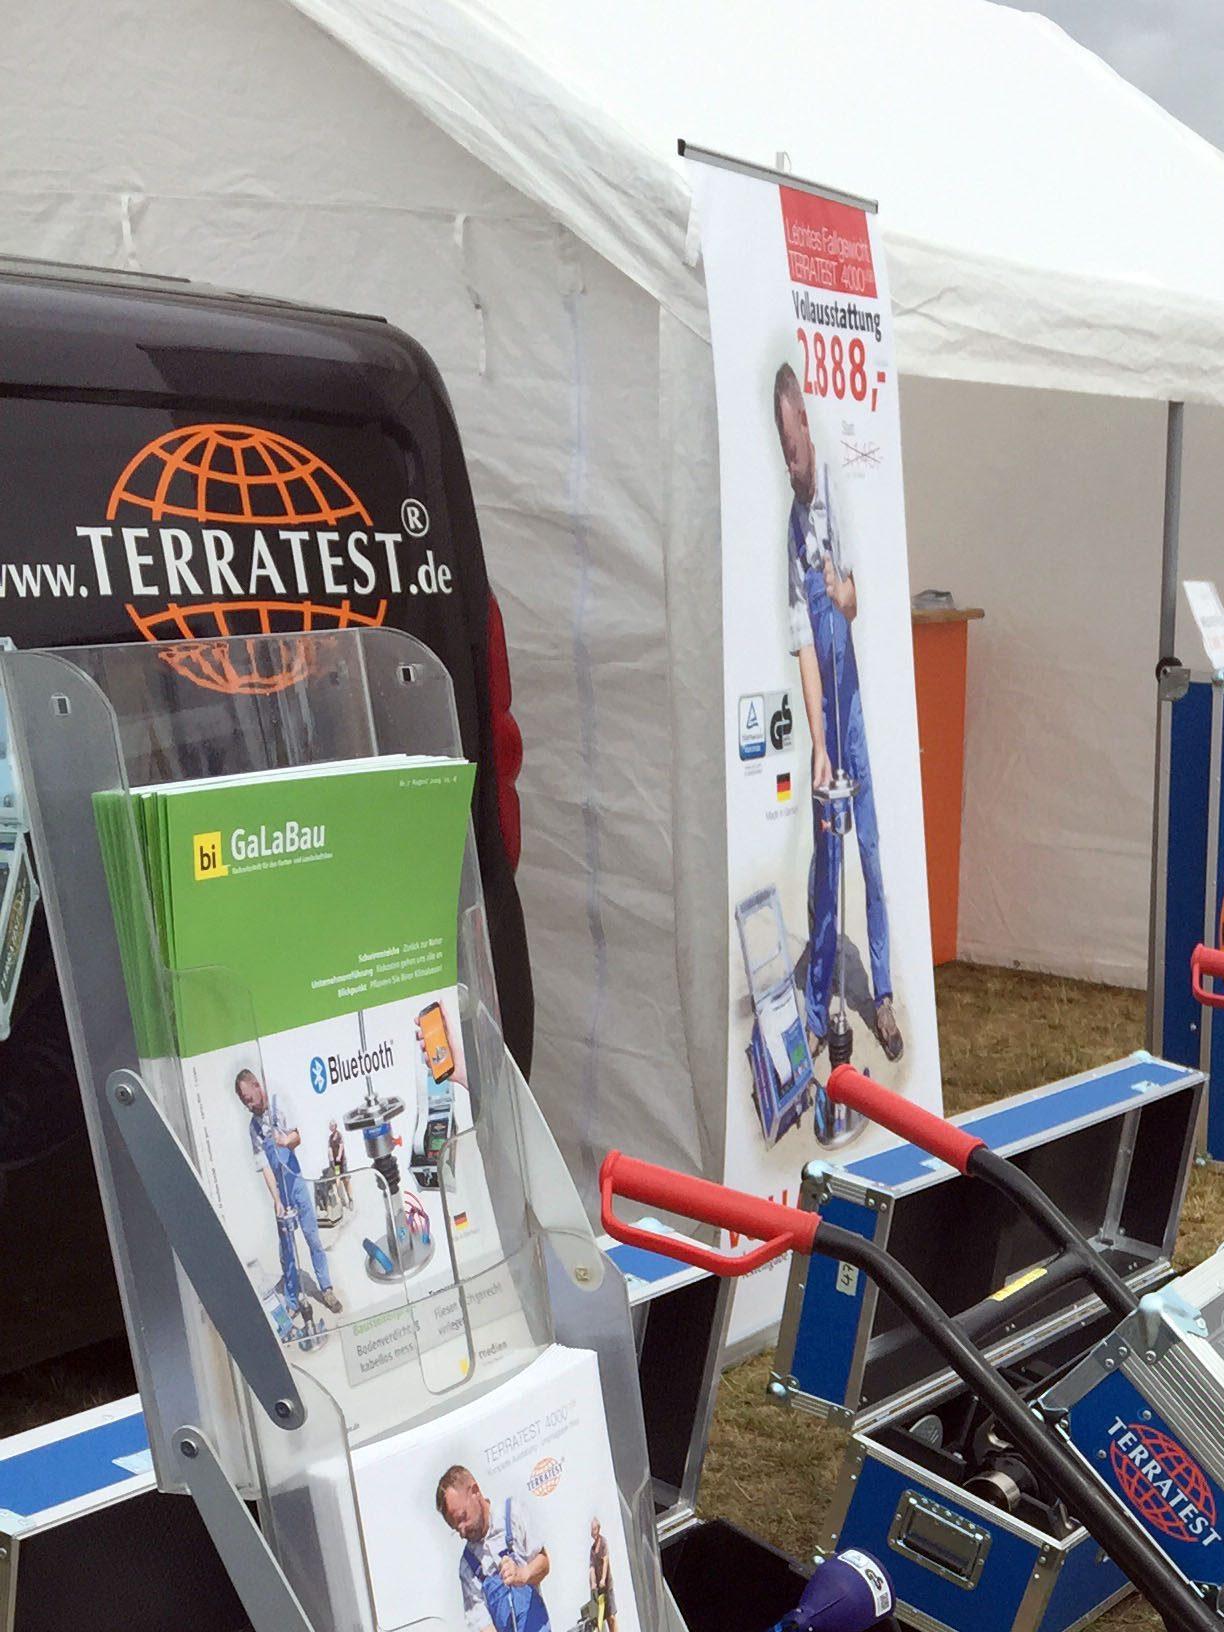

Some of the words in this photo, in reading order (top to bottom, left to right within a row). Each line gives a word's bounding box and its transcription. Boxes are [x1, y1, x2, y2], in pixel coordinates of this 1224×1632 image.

[788, 250, 838, 286] TERRATEST
[792, 290, 881, 342] Vollausstattung
[797, 327, 886, 412] 2.888,-
[200, 844, 217, 871] bi
[231, 820, 326, 861] GaLaBau
[327, 1041, 394, 1086] Bluetooth
[484, 1420, 542, 1463] TERRATEST
[526, 1463, 563, 1491] TERRATEST
[1106, 1416, 1224, 1548] TERRATEST
